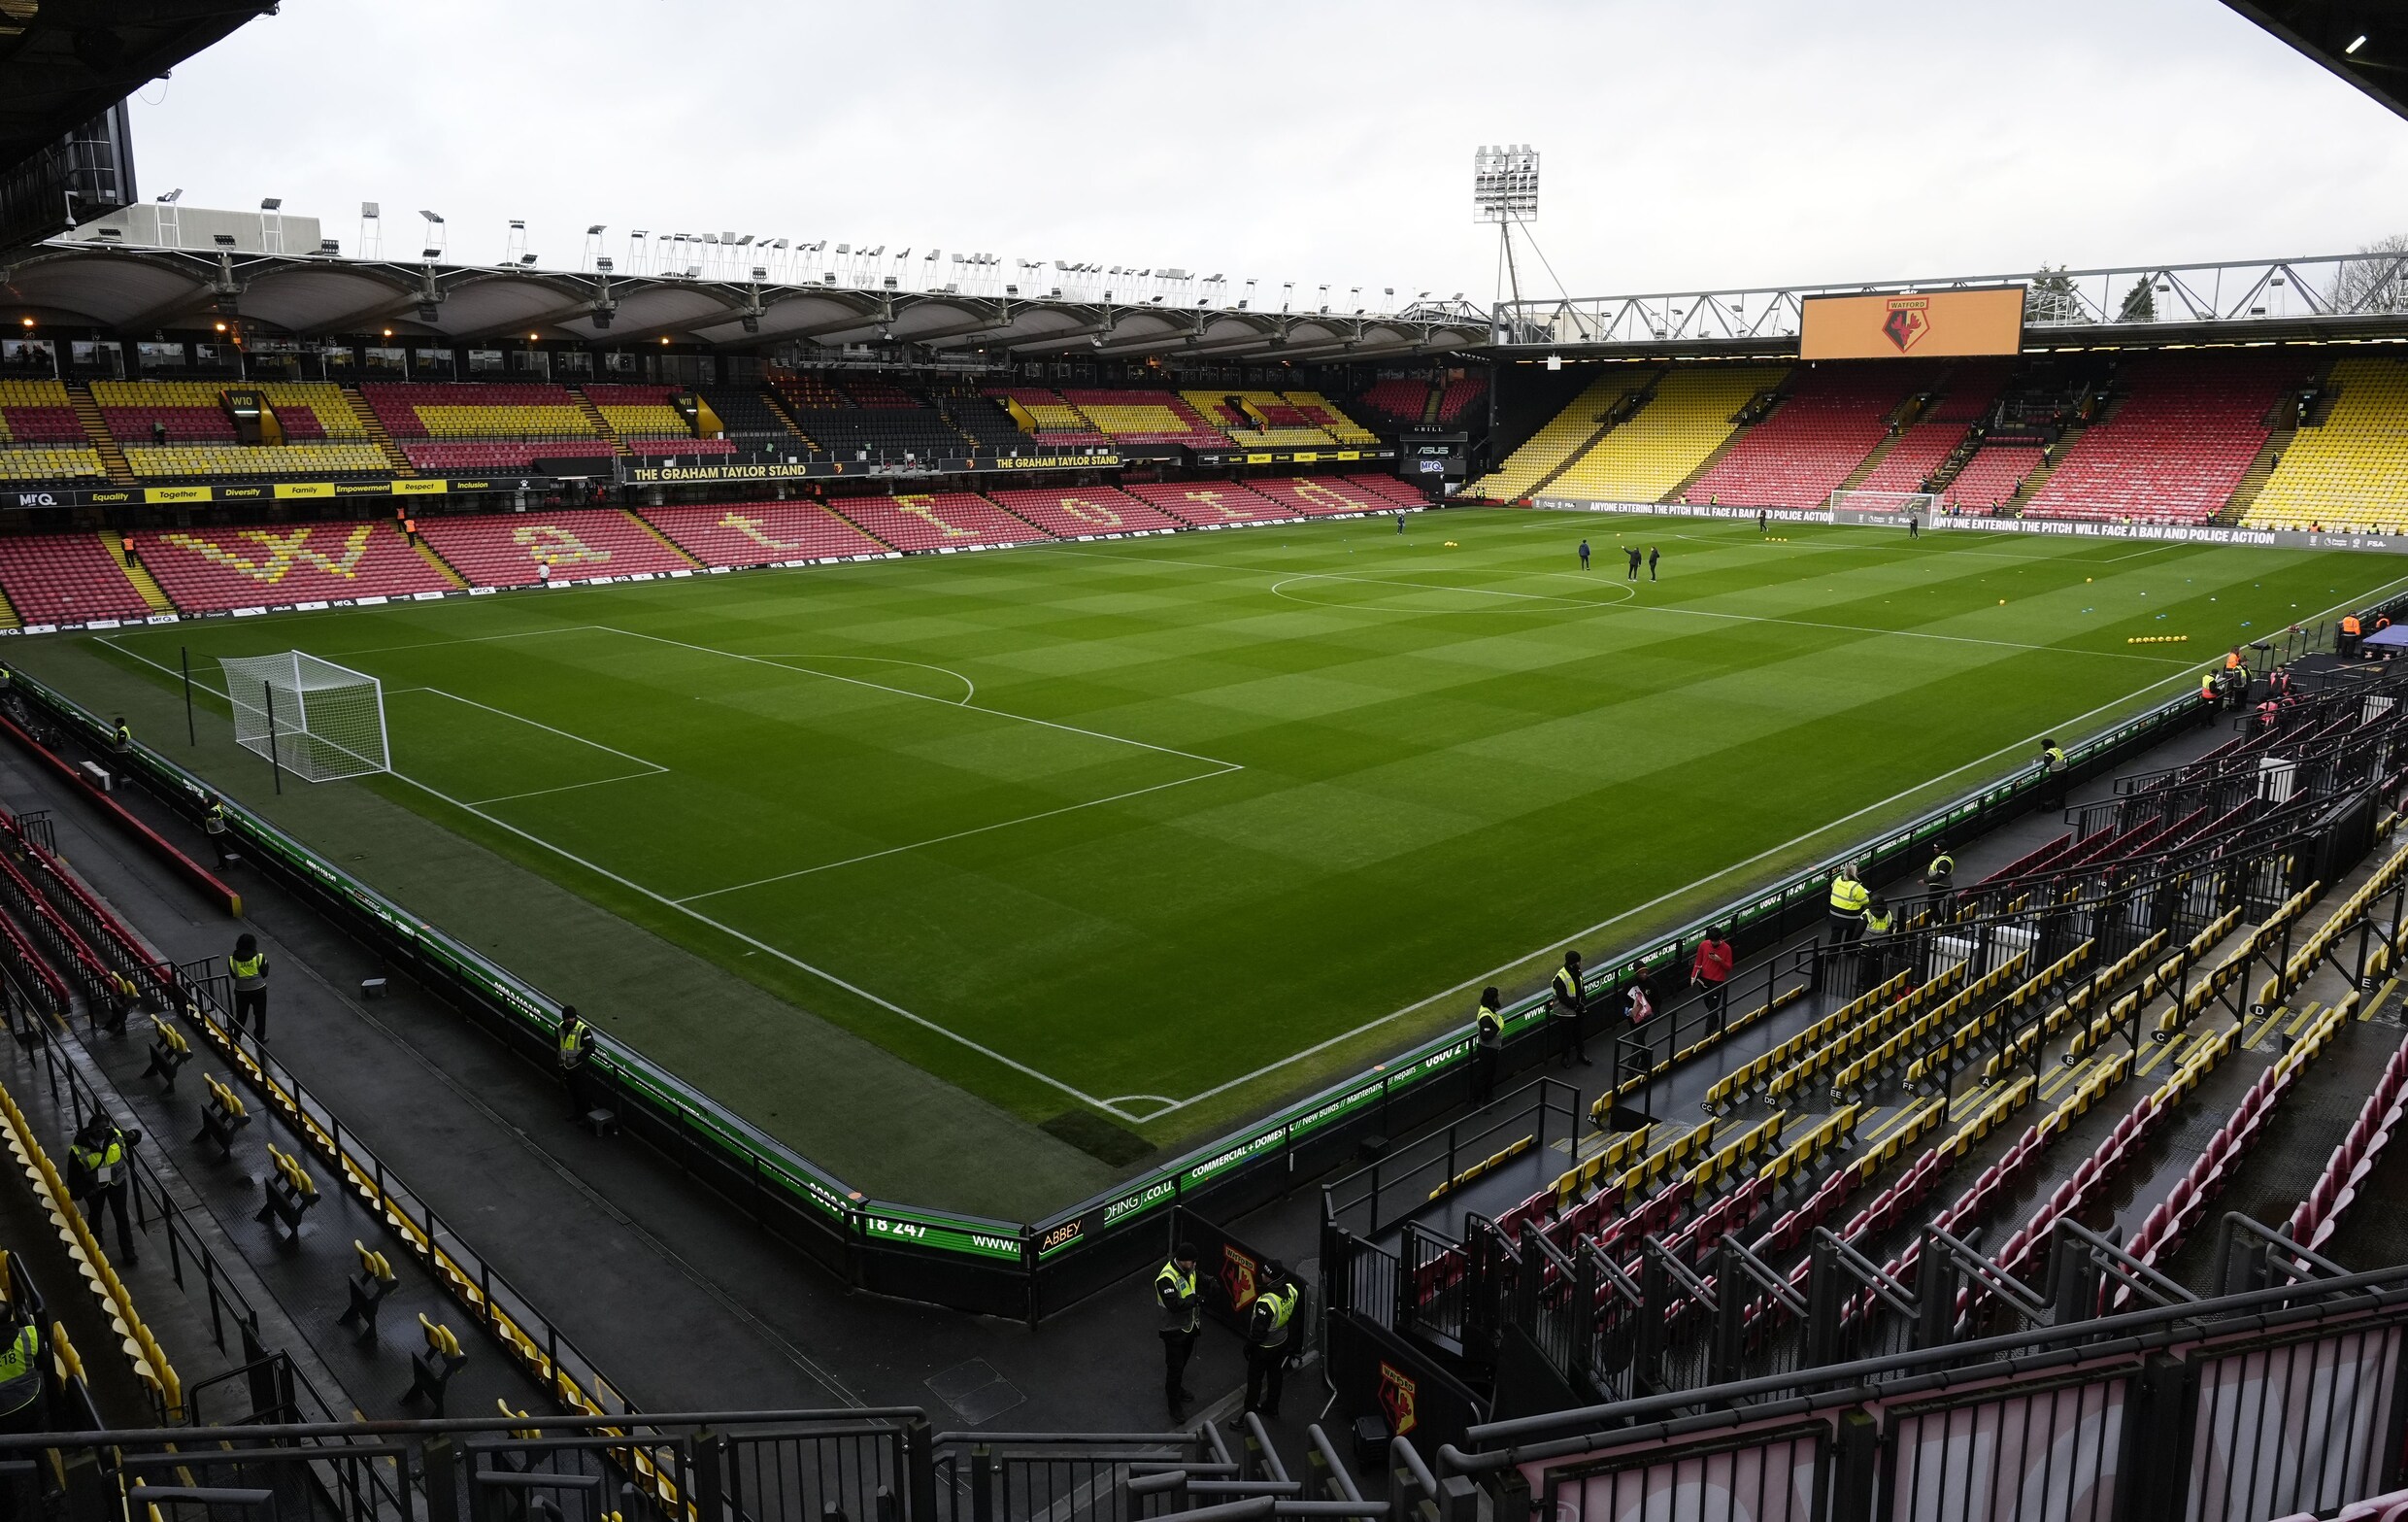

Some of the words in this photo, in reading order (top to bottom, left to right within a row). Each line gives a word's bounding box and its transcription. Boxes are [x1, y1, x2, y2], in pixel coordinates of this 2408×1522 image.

[232, 396, 252, 406] W10
[679, 397, 692, 406] W11
[996, 458, 1014, 468] THE
[1016, 457, 1056, 468] GRAHAM
[1058, 457, 1089, 466] TAYLOR
[1091, 456, 1119, 465] STAND
[1421, 461, 1444, 473] MrQ
[634, 469, 658, 481] THE
[661, 467, 719, 480] GRAHAM
[721, 466, 766, 478] TAYLOR
[769, 464, 806, 477] STAND
[225, 488, 260, 496] Diversity
[336, 484, 390, 493] Empowerment
[19, 493, 57, 506] MrQ
[92, 492, 129, 501] Equality
[159, 490, 197, 499] Together
[1590, 502, 1618, 512] ANYONE
[1619, 503, 1654, 514] ENTERING
[1655, 504, 1668, 515] THE
[1669, 505, 1691, 516] PITCH
[1692, 506, 1711, 517] WILL
[1712, 507, 1731, 518] FACE
[1731, 508, 1738, 518] A
[1739, 508, 1755, 519] BAN
[1756, 509, 1774, 520] AD
[1774, 510, 1803, 521] POLICE
[1803, 511, 1834, 523] ACTION
[1932, 517, 1971, 528] ANYONE
[1972, 519, 2020, 531] ENTERING
[2021, 521, 2040, 532] THE
[2041, 522, 2072, 534] PITCH
[2075, 524, 2100, 535] WILL
[2101, 524, 2127, 537] FACE
[2128, 525, 2138, 537] A
[2139, 526, 2162, 538] BAN
[2163, 527, 2188, 540] AND
[2189, 528, 2229, 542] POLICE
[2229, 530, 2275, 545] ACTION
[2361, 977, 2371, 989] E
[2255, 1005, 2264, 1016] D
[2156, 1032, 2165, 1042] C
[2066, 1056, 2075, 1065] B
[1902, 1082, 1915, 1092] FF
[1982, 1077, 1990, 1087] A
[1830, 1089, 1842, 1099] EE
[1763, 1097, 1775, 1106] DD
[1700, 1102, 1713, 1113] CC
[1587, 1115, 1597, 1124] AA
[1192, 1147, 1247, 1178] COMMERCIAL
[1302, 1112, 1319, 1126] New
[1347, 1081, 1384, 1104] Maintenanc
[1042, 1220, 1082, 1250] ABBEY
[973, 1235, 1018, 1253] www.
[1226, 1248, 1254, 1270] WATFORD
[1384, 1366, 1414, 1392] WATFORD
